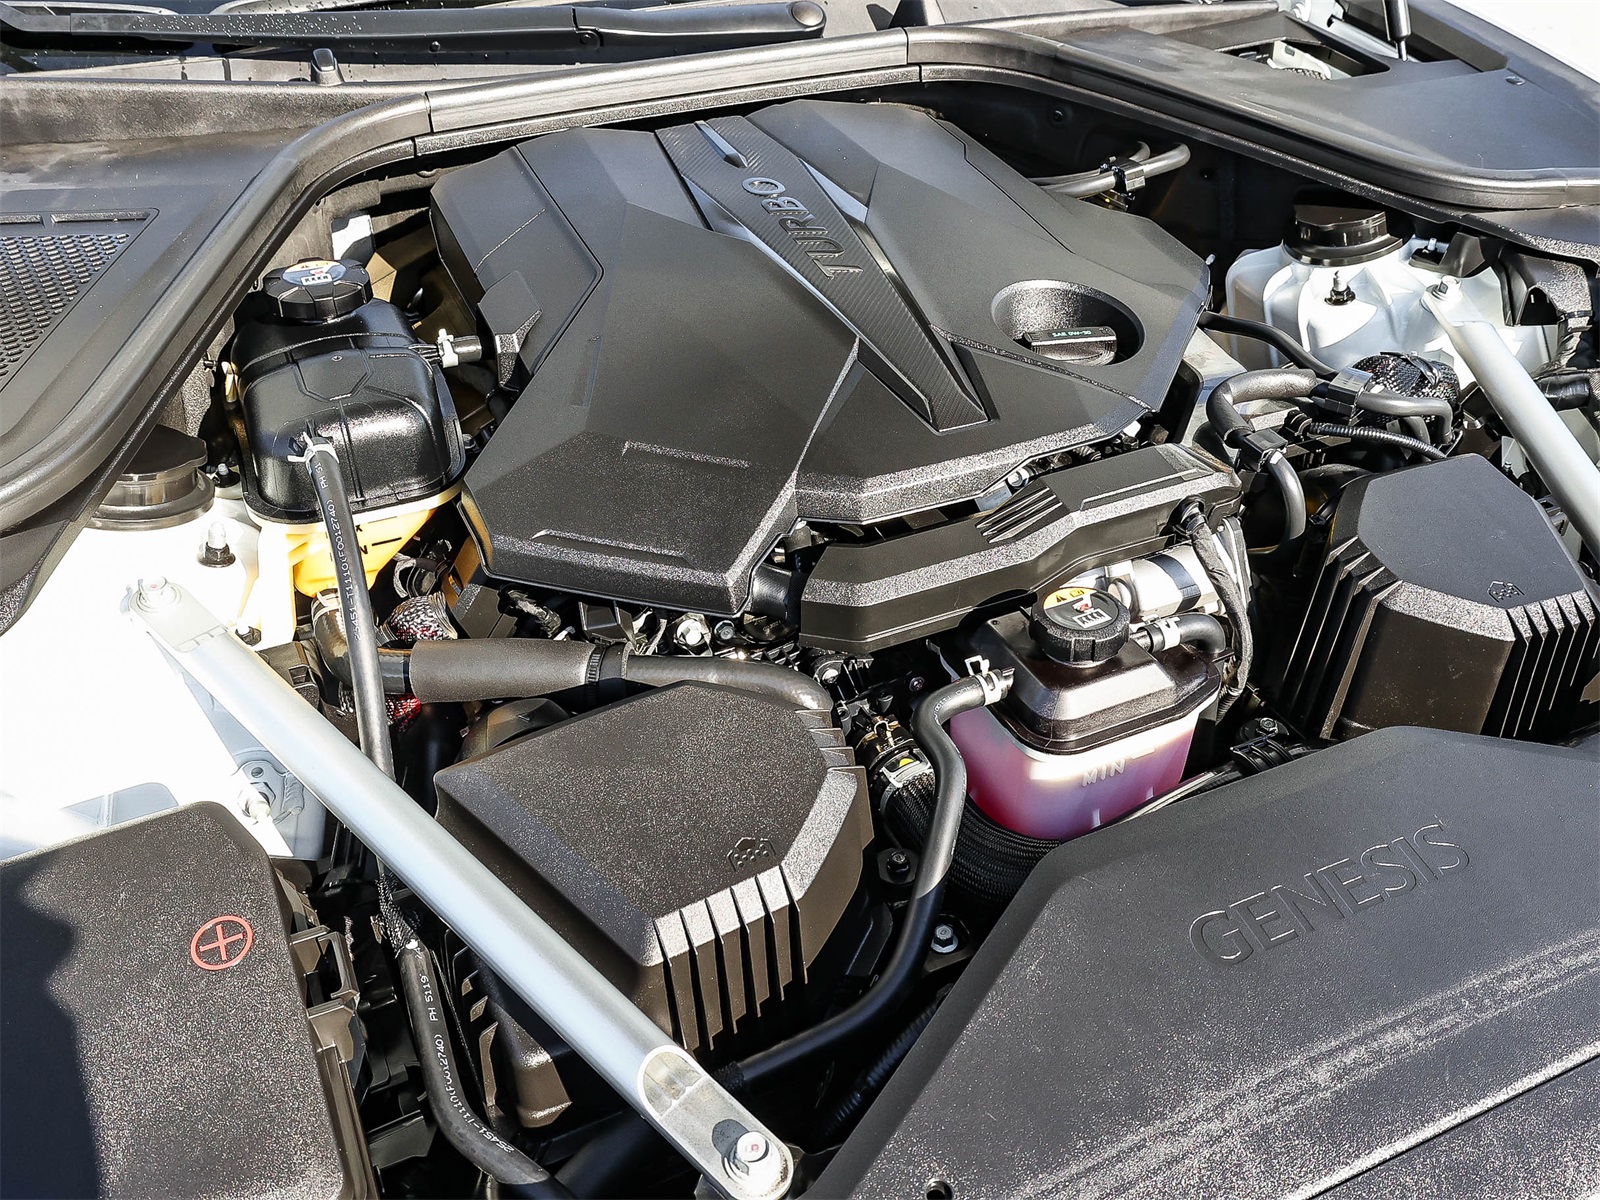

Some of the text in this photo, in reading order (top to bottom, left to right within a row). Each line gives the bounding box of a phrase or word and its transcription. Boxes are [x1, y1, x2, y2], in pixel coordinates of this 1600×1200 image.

[742, 177, 864, 279] TURBO
[1081, 758, 1126, 787] MIN
[1188, 820, 1470, 966] GENESIS
